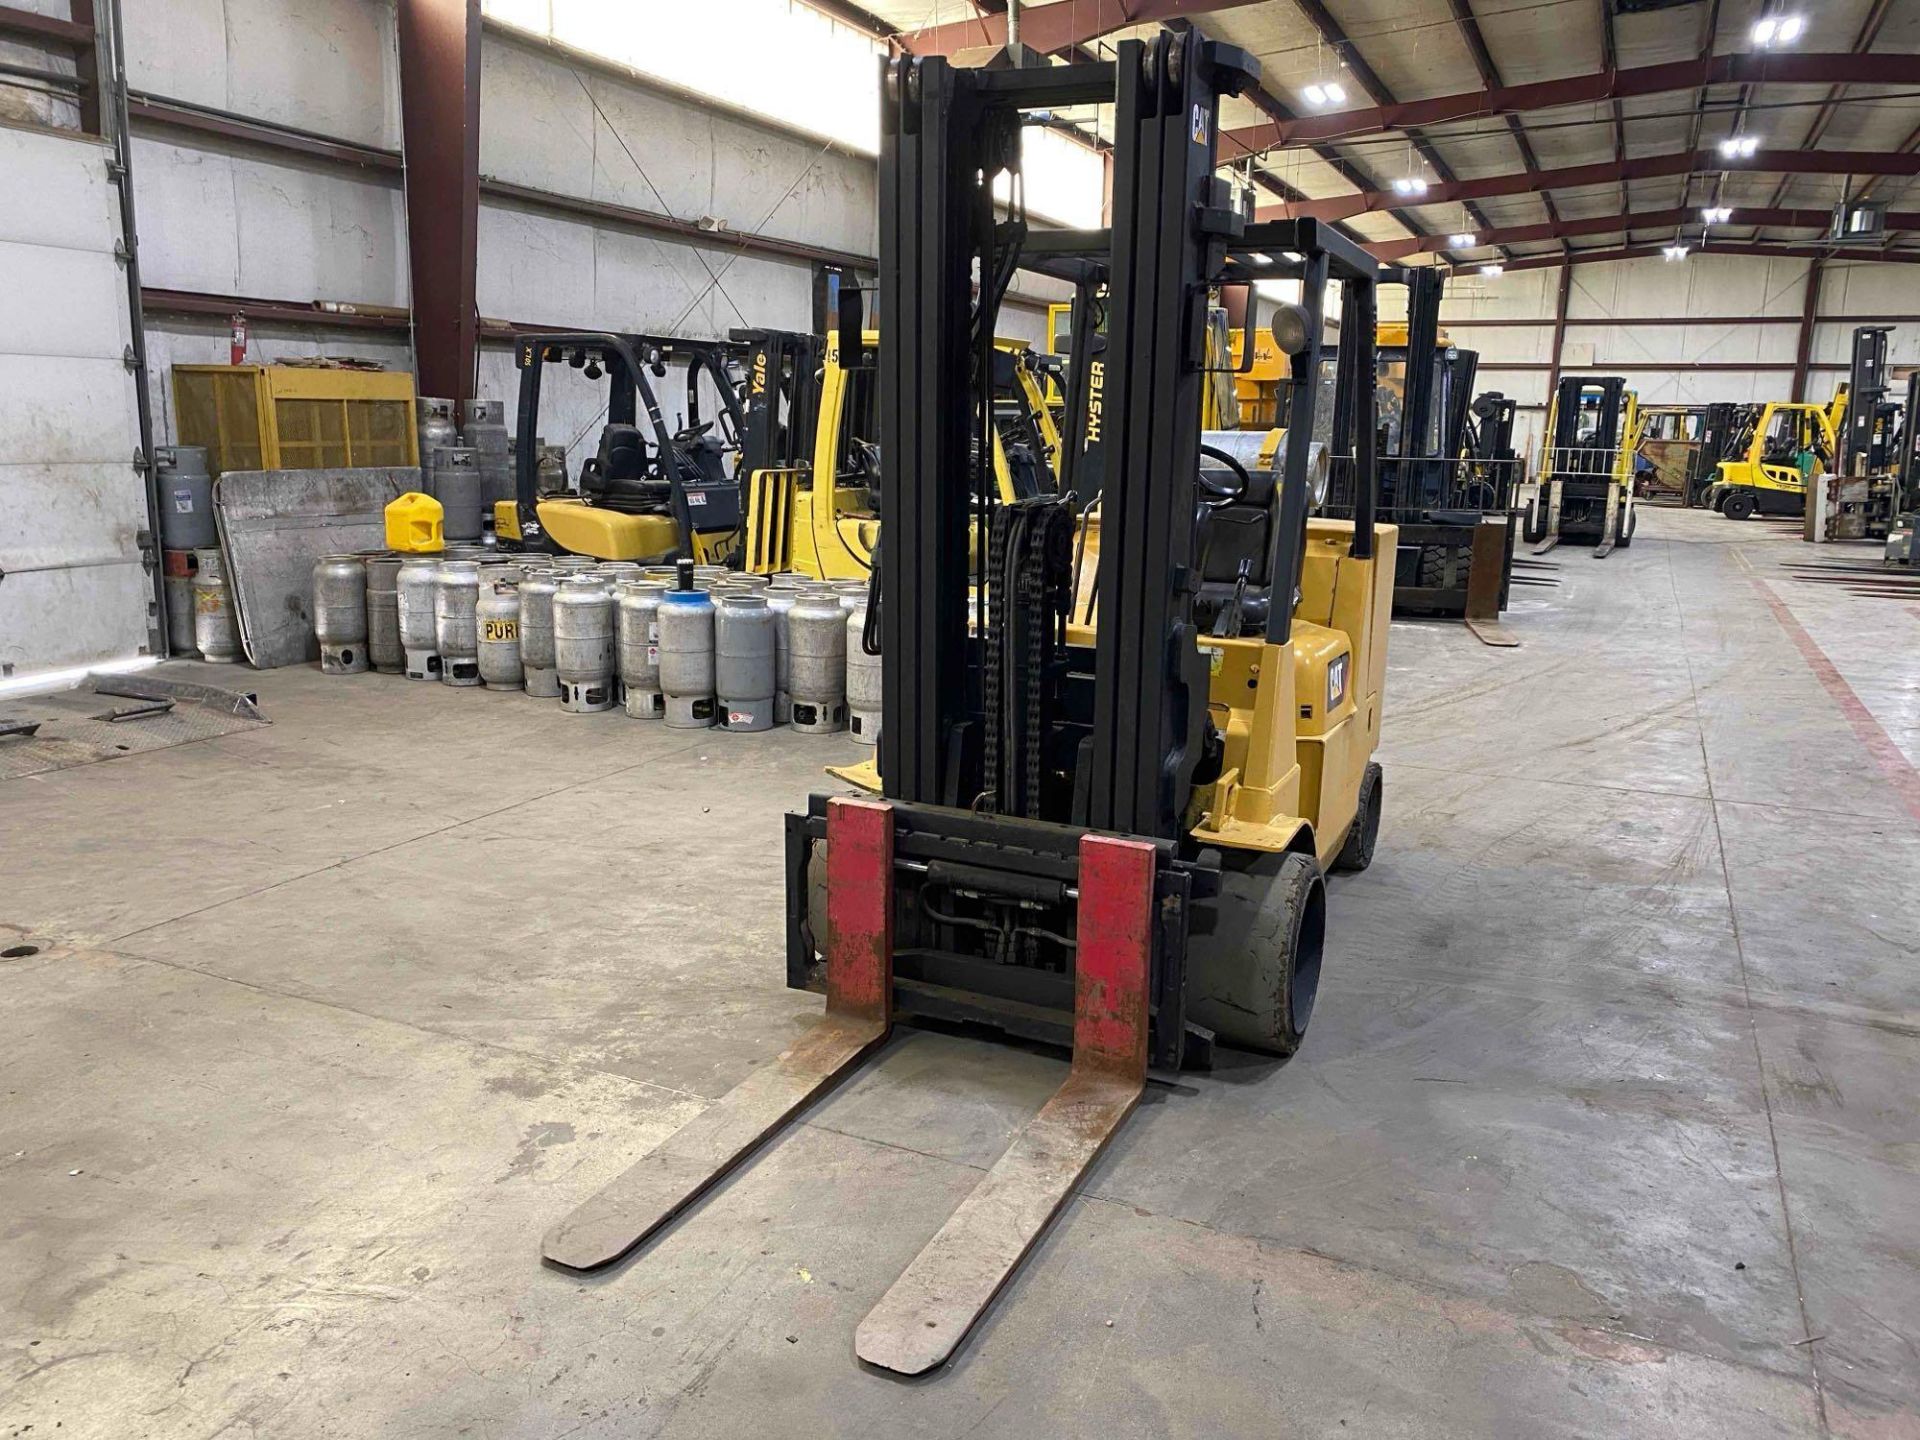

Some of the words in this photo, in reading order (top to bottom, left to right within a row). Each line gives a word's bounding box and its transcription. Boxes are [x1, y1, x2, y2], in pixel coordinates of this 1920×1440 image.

[1192, 103, 1210, 146] CAT
[752, 353, 767, 394] Yale
[1088, 361, 1105, 442] HYSTER
[1330, 662, 1343, 701] CAT
